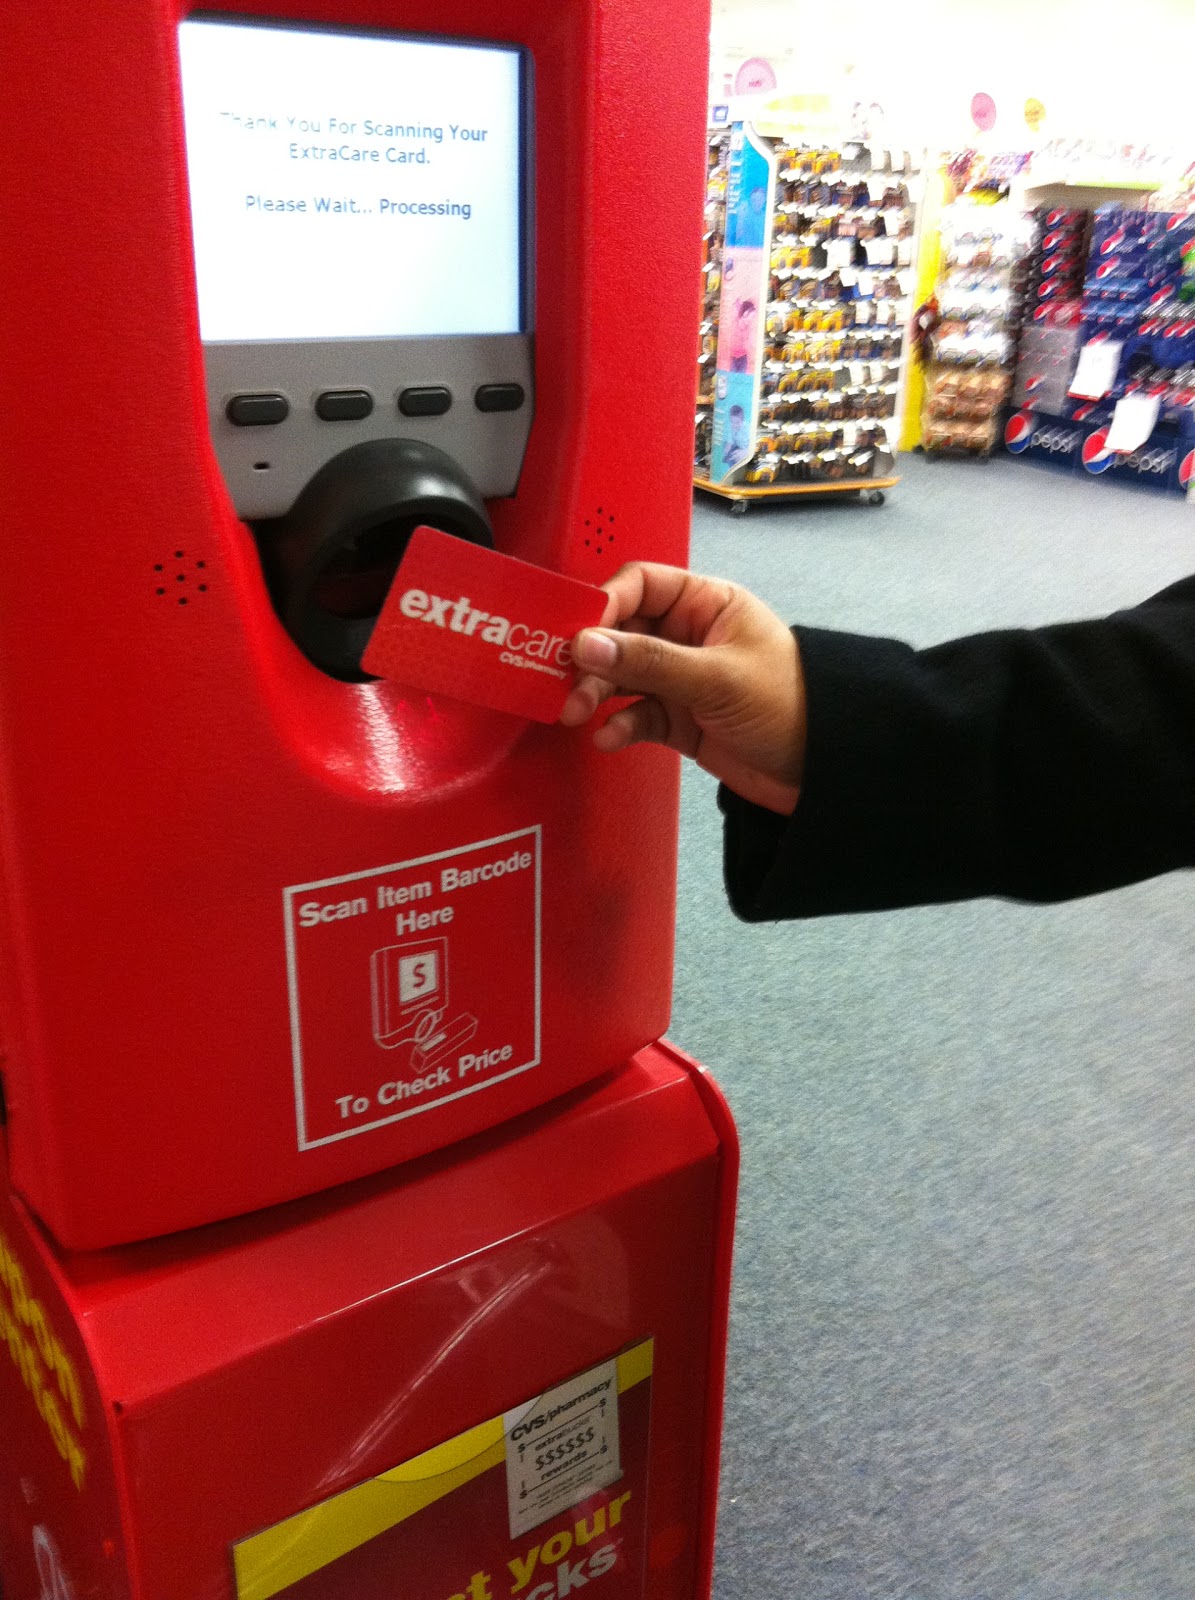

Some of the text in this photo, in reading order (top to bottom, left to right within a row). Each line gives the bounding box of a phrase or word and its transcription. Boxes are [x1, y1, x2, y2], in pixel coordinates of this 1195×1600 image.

[286, 115, 321, 133] You
[329, 118, 356, 134] For
[363, 120, 443, 143] Scanning
[449, 124, 488, 142] Your
[289, 143, 431, 164] ExtraCare Card.
[245, 195, 472, 220] Please Wait... Processing
[400, 588, 574, 667] extracare
[299, 850, 533, 928] Scan Item Barcode
[396, 905, 454, 936] Here
[335, 1042, 513, 1119] To Check Price
[510, 1378, 612, 1441] CVS/pharmacy
[541, 1450, 588, 1480] rewards
[507, 1489, 632, 1594] your
